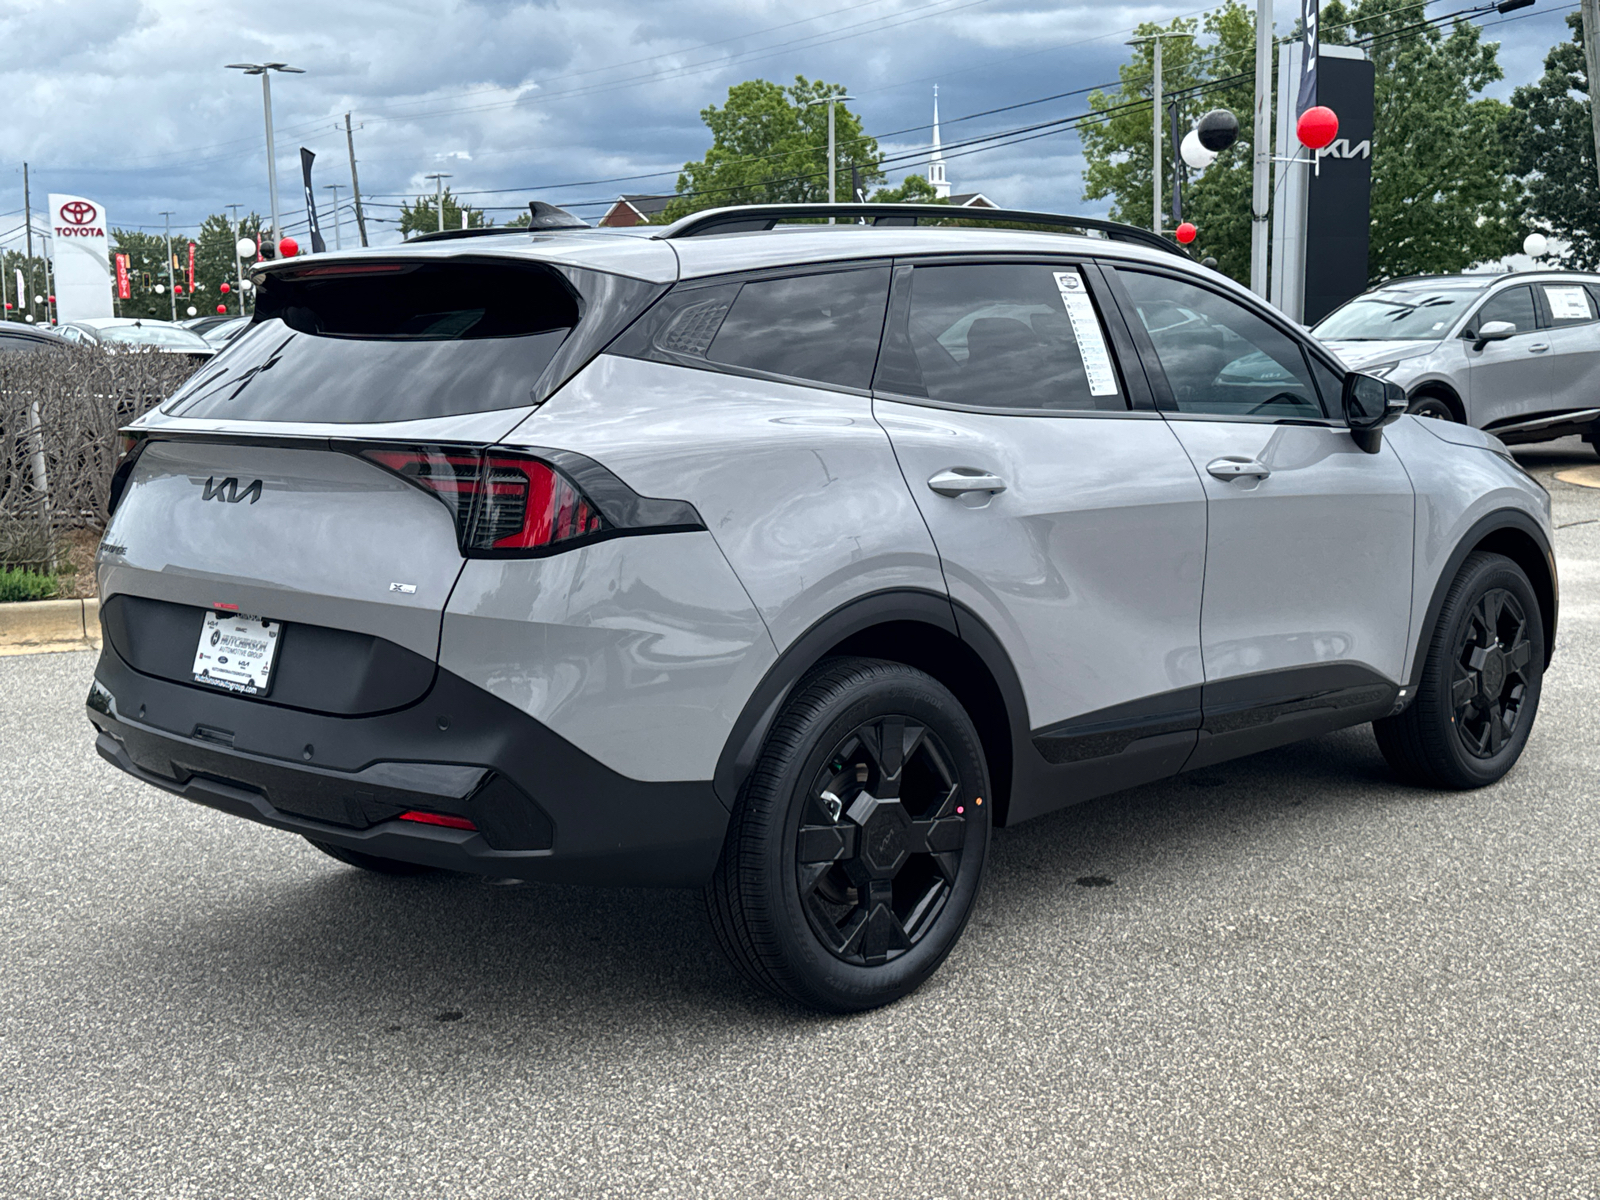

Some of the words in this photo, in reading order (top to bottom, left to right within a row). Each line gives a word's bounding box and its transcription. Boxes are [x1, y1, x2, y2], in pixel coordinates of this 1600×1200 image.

[54, 227, 105, 237] TOYOTA
[120, 262, 128, 297] TOYOTA
[202, 476, 263, 505] KIA
[220, 635, 268, 652] HUTCHINSON
[218, 646, 247, 656] AUTOMOTIVE
[246, 650, 264, 659] GROUP
